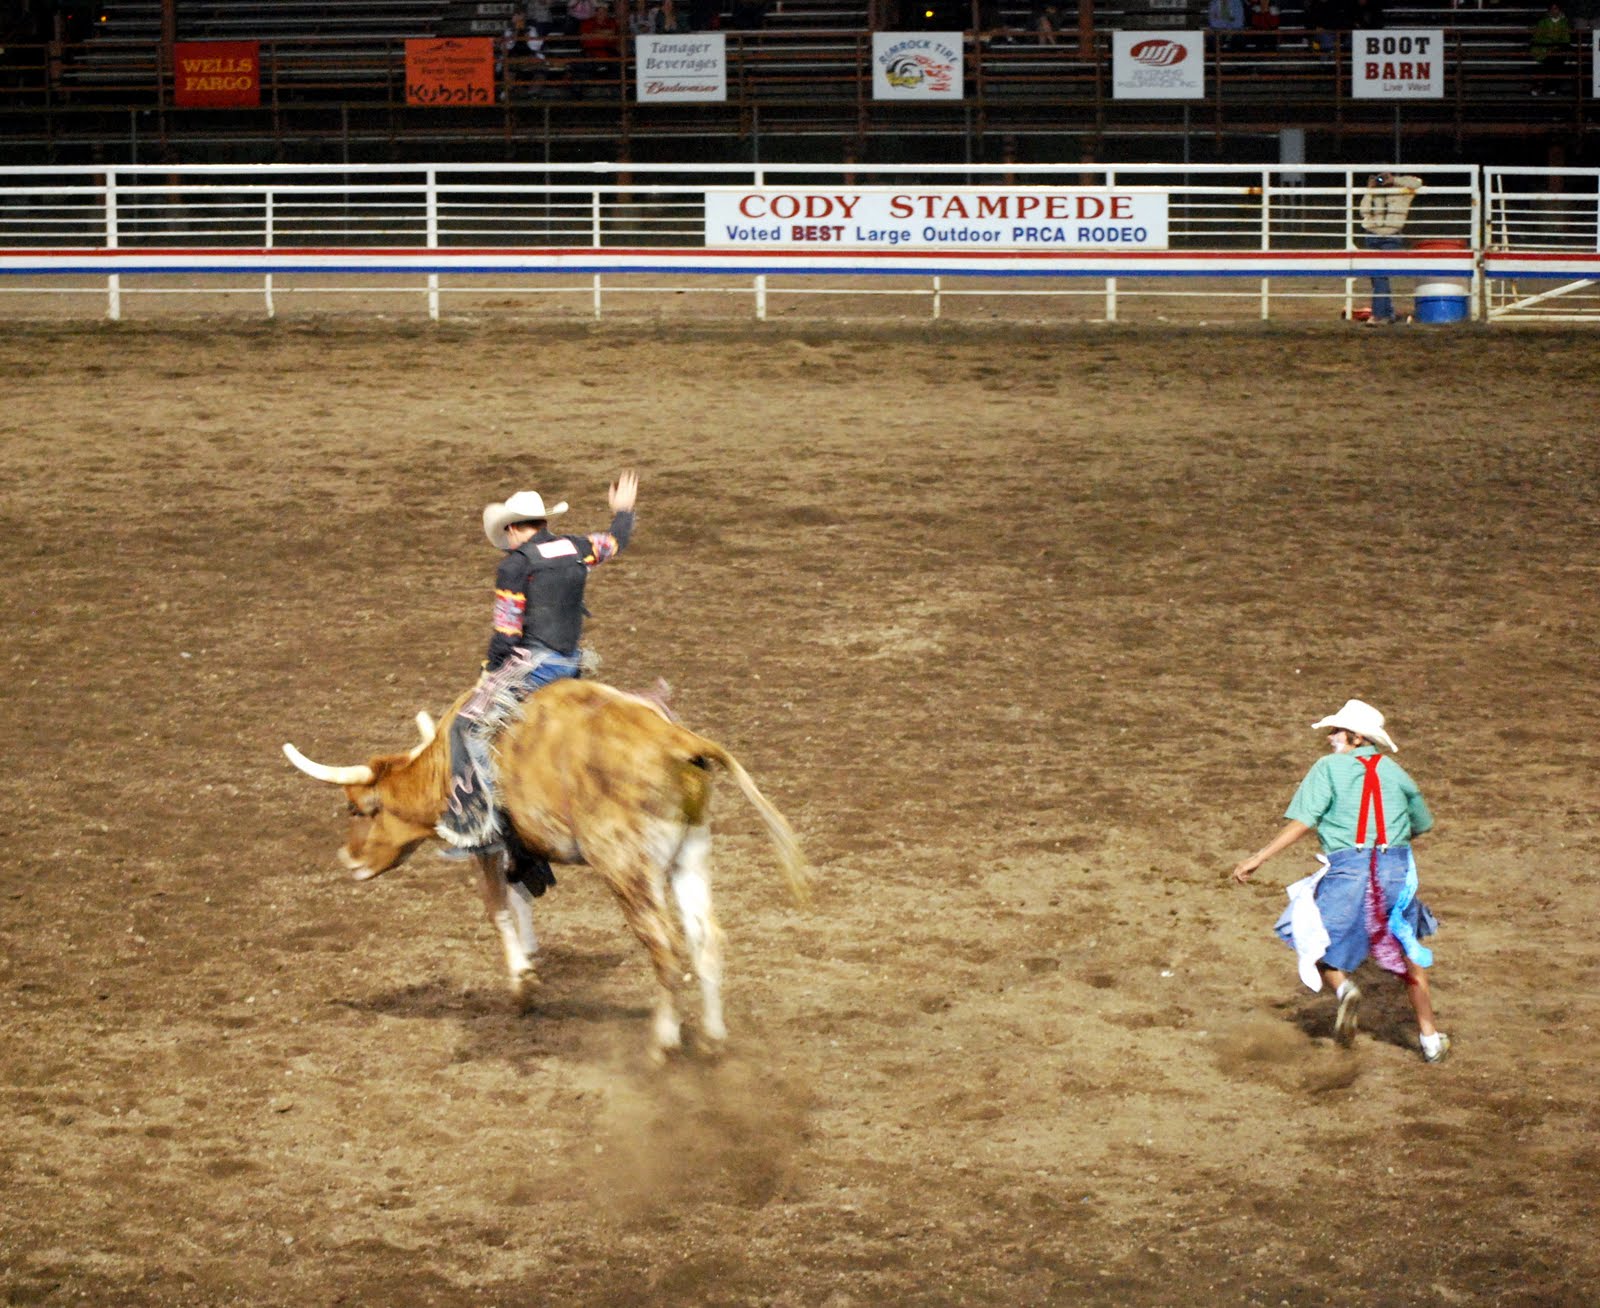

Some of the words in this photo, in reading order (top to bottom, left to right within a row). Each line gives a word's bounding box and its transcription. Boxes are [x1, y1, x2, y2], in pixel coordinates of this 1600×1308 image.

[651, 42, 711, 56] Tanager
[1366, 37, 1430, 54] BOOT
[182, 59, 252, 73] WELLS
[646, 58, 718, 71] Beverages
[1365, 62, 1430, 79] BARN
[185, 76, 252, 91] FARGO
[408, 84, 488, 102] Kubota
[739, 195, 861, 218] CODY
[890, 195, 1134, 219] STAMPEDE
[727, 226, 781, 240] Voted
[792, 225, 845, 241] BEST
[856, 227, 911, 244] Large
[923, 227, 1001, 242] Outdoor
[1012, 227, 1066, 242] PRCA
[1078, 227, 1147, 242] RODEO
